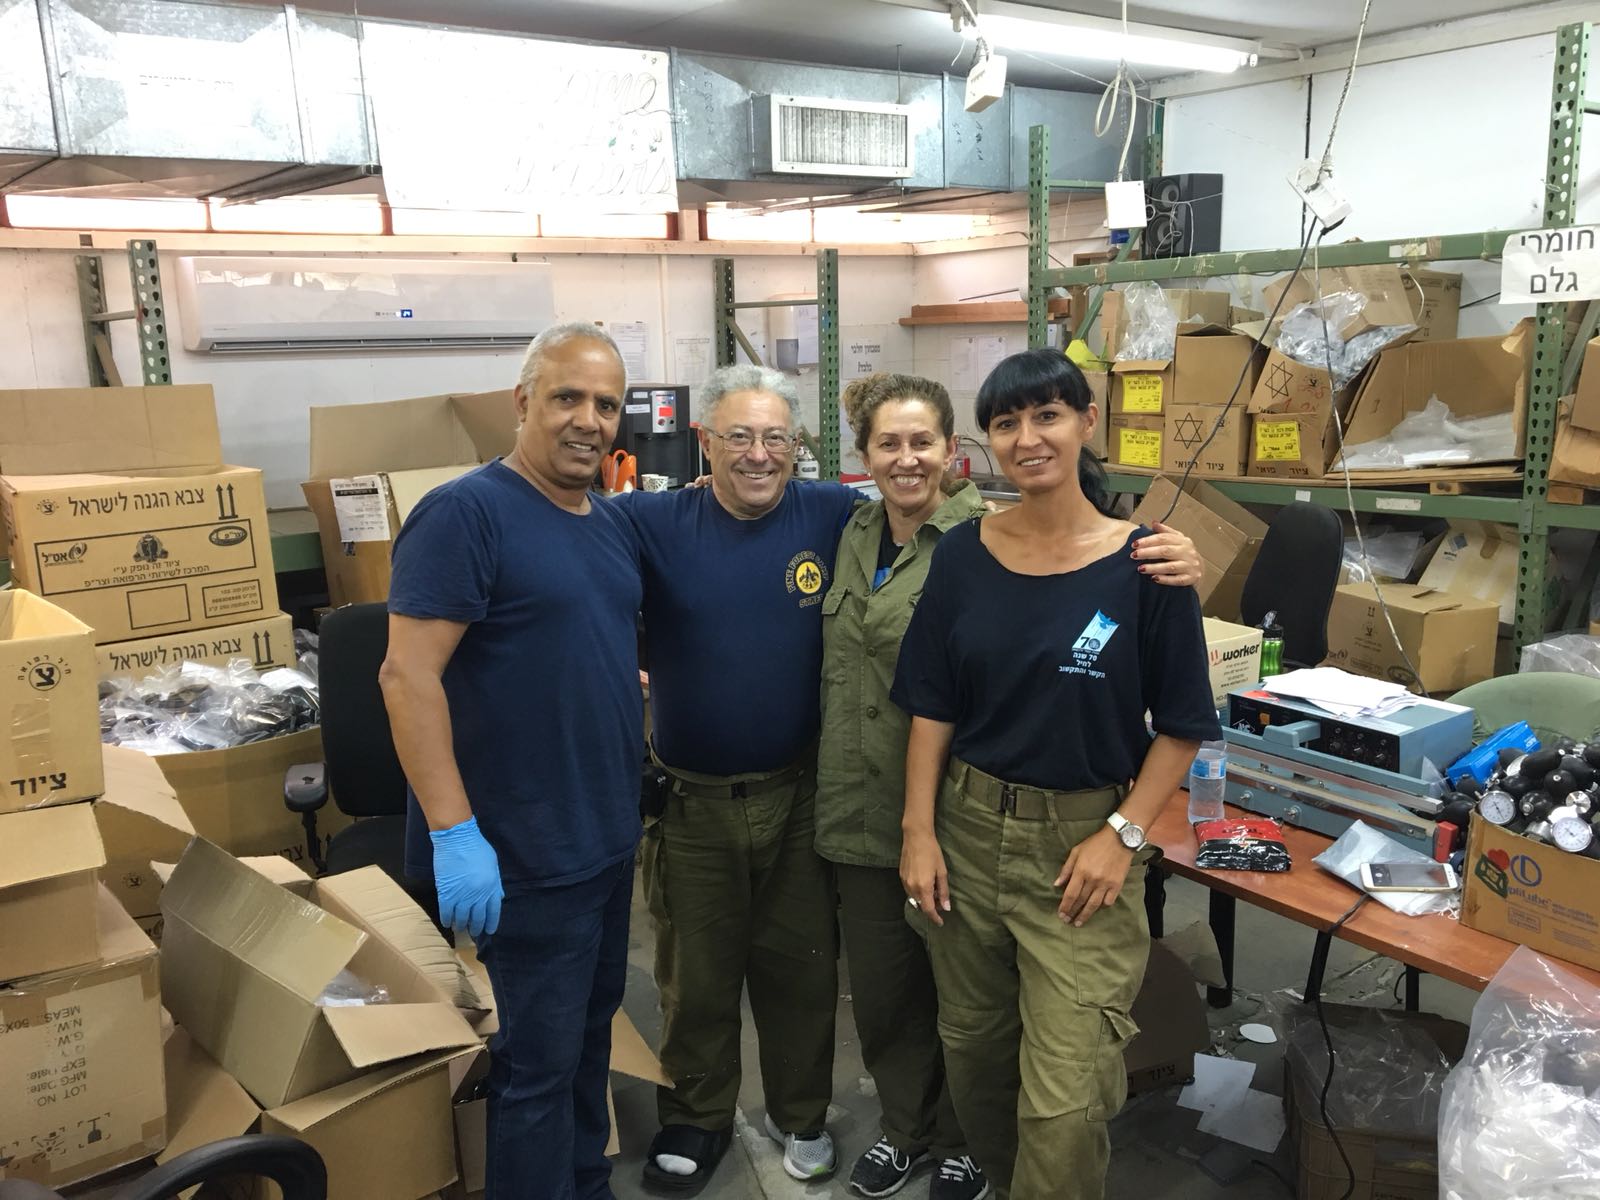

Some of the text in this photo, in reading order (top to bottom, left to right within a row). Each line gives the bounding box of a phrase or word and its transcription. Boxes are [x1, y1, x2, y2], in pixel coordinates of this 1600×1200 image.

[1521, 229, 1594, 253] חומרי
[1530, 266, 1578, 294] גלם
[1206, 462, 1225, 471] ציוד
[1256, 466, 1309, 475] ציוד פואי
[68, 487, 205, 517] צבא הגנה לישראל
[212, 637, 242, 656] צבא
[1222, 644, 1259, 661] worker
[109, 645, 167, 671] לישראל
[10, 772, 67, 796] ציוד
[61, 1057, 86, 1073] EXP
[60, 1070, 87, 1086] MFG
[63, 1084, 87, 1100] LOT
